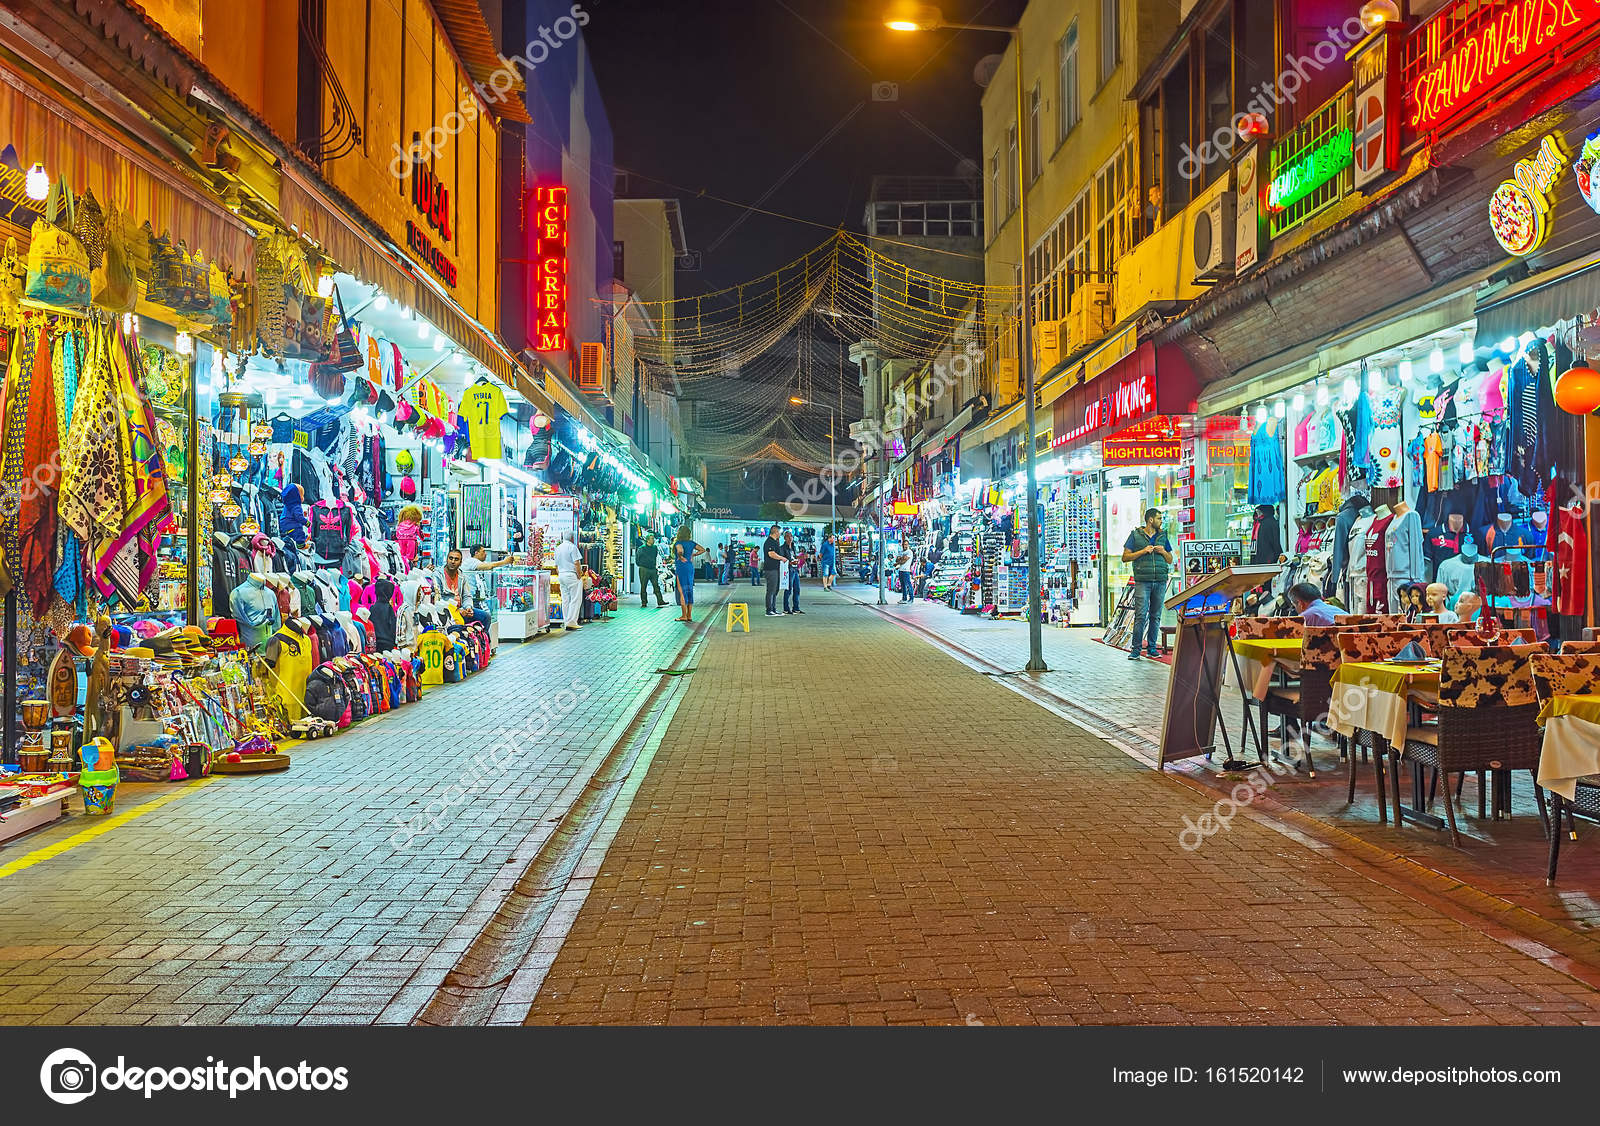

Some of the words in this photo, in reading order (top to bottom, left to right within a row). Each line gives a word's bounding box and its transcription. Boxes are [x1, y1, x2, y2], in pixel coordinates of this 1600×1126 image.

[1514, 138, 1561, 215] Pizza
[544, 188, 559, 239] ICE
[541, 258, 562, 350] CREAM
[1084, 400, 1100, 432] CUT
[1101, 392, 1115, 427] BY
[1115, 375, 1147, 419] VIKING
[1105, 447, 1180, 459] HIGHTLIGHT
[425, 649, 441, 669] 10
